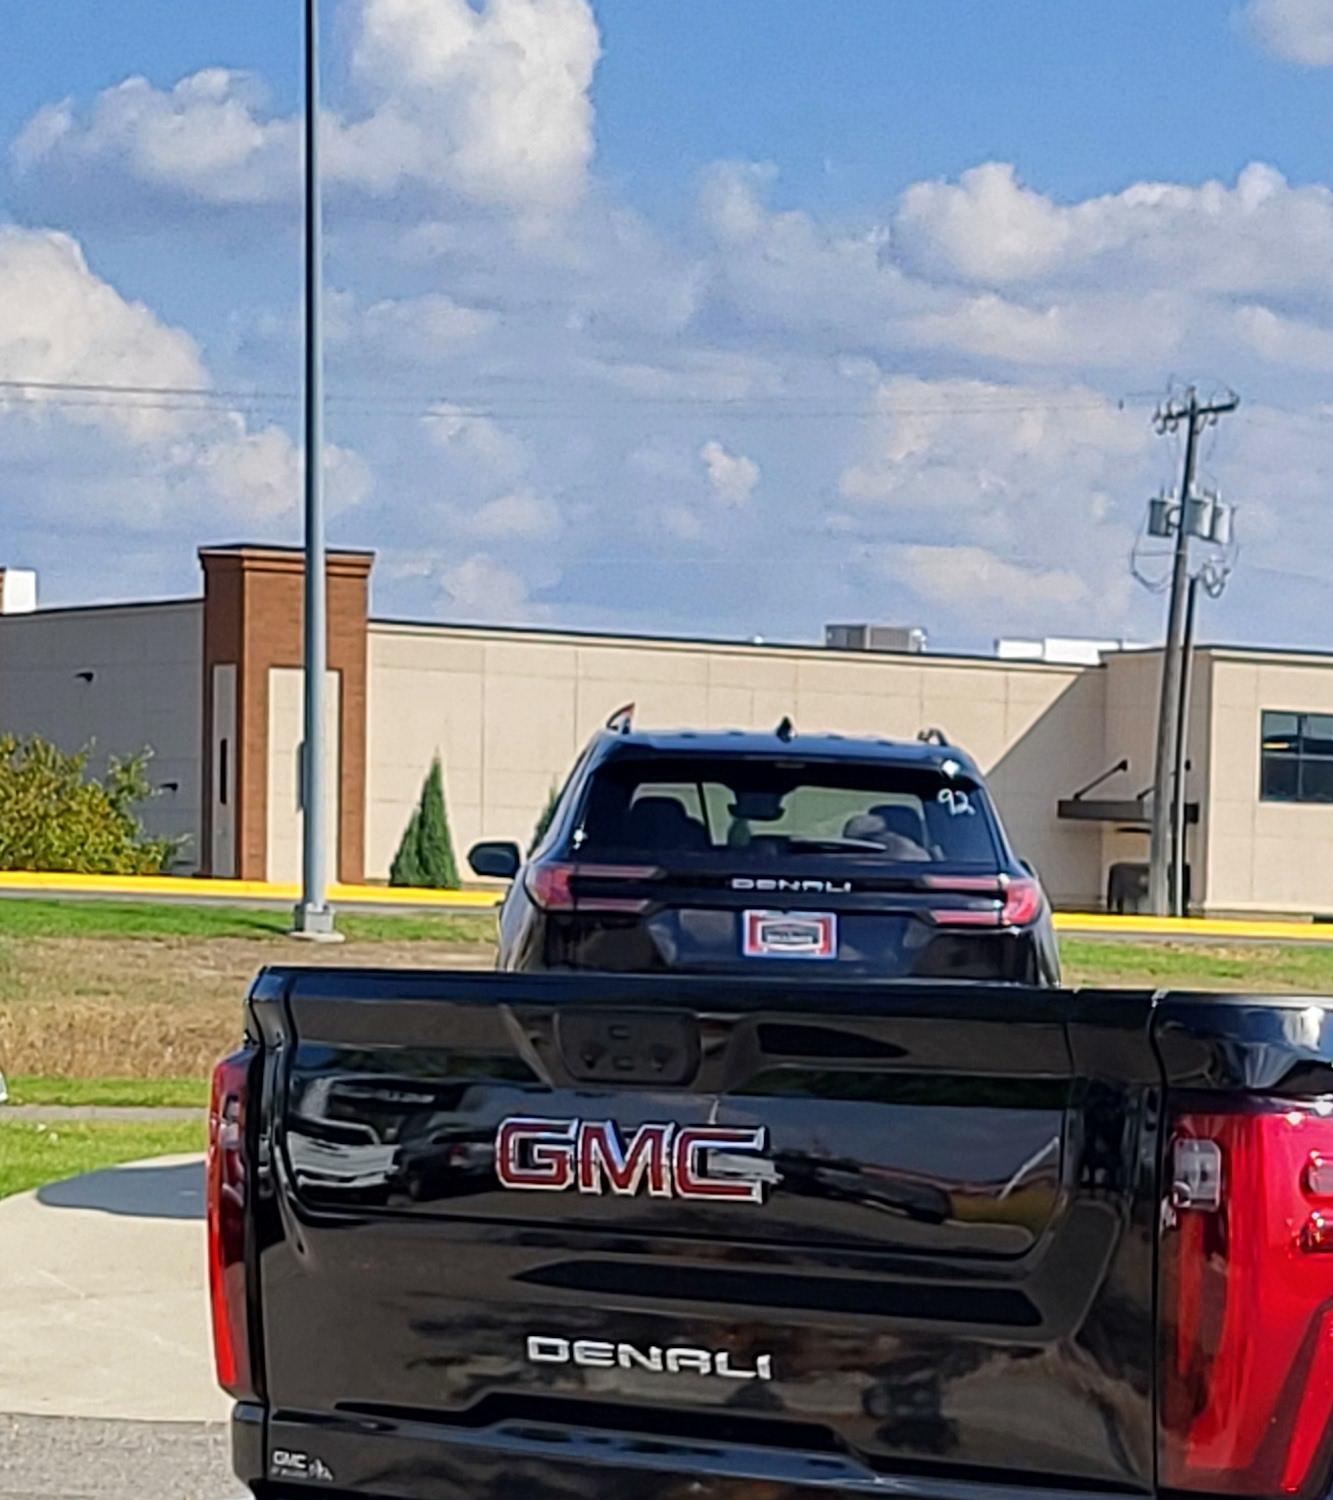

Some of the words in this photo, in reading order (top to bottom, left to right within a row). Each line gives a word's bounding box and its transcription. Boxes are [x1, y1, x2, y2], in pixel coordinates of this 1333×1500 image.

[938, 788, 976, 816] 92
[731, 878, 852, 893] DENALI
[495, 1117, 766, 1204] GMC
[527, 1335, 772, 1380] DENALI
